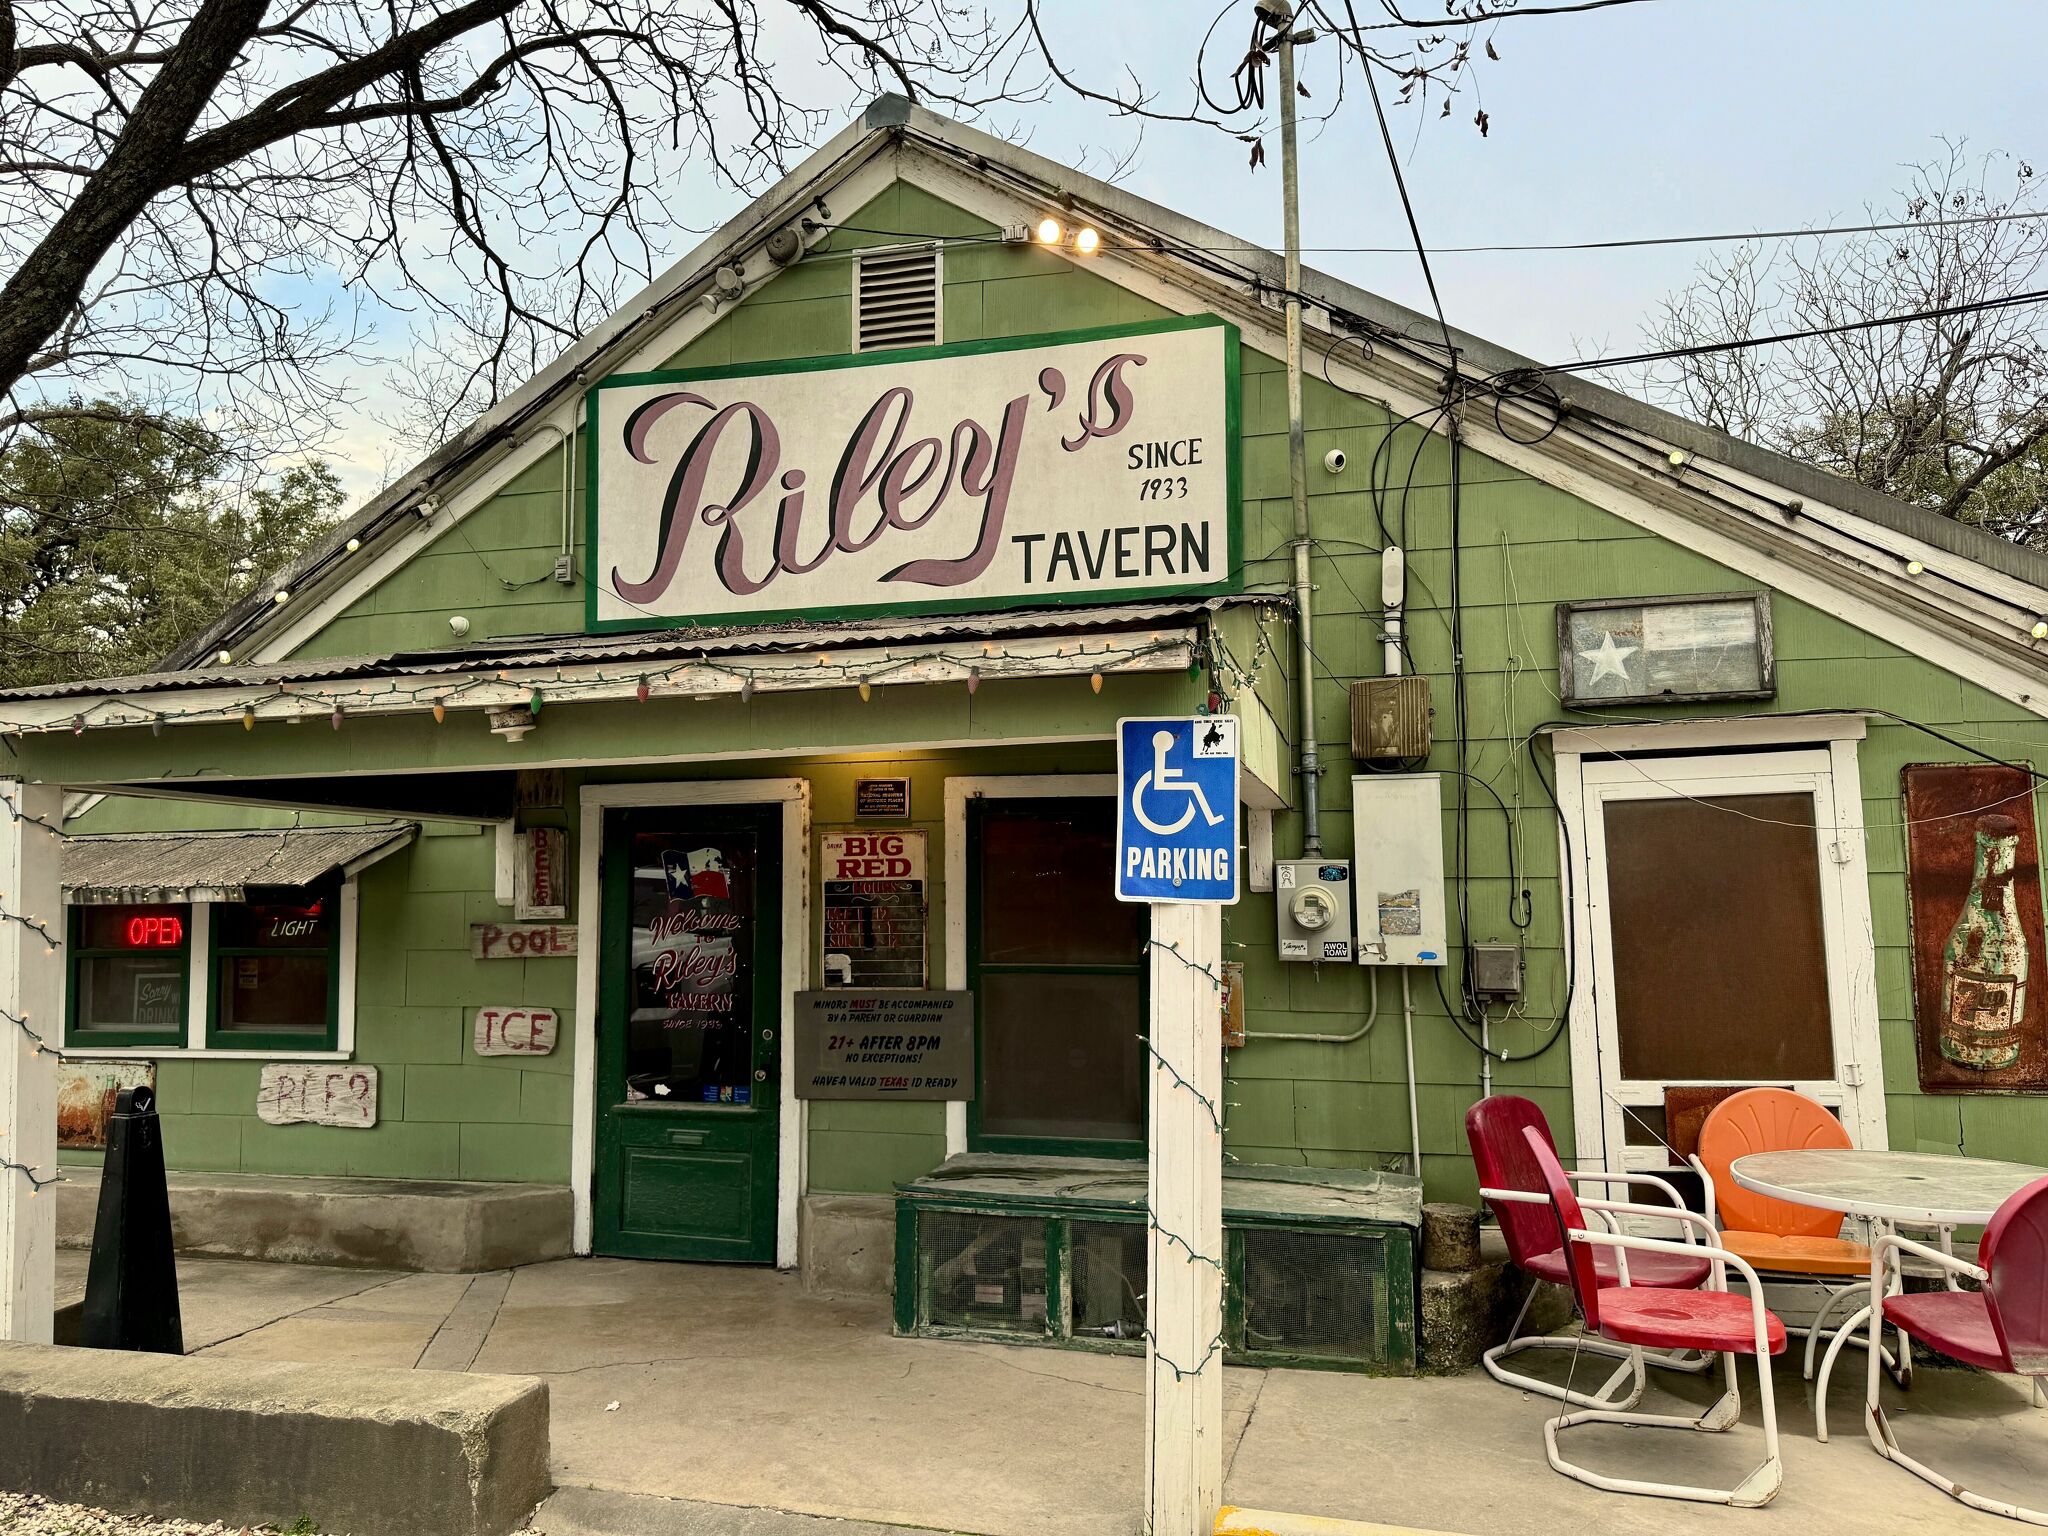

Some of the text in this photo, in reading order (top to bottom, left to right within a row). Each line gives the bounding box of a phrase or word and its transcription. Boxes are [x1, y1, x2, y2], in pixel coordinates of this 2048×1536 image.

[1127, 437, 1203, 471] SINCE
[611, 353, 1148, 604] Riley's
[1139, 476, 1189, 501] 1933
[1011, 520, 1210, 584] TAVERN
[843, 836, 904, 857] BIG
[836, 858, 912, 878] RED
[1126, 847, 1229, 881] PARKING
[852, 881, 897, 895] HOURS
[271, 919, 319, 937] LIGHT
[649, 909, 740, 947] Welcome
[482, 924, 568, 958] POOL
[1324, 942, 1347, 950] AWOL
[652, 945, 738, 993] Riley's
[140, 982, 172, 1002] Sorry
[665, 992, 733, 1013] TAVERN
[813, 999, 954, 1010] MINORS MUST BE ACCOMPANIED
[827, 1013, 943, 1023] BY A PARENT OR GUARDIAN
[828, 1035, 941, 1052] 21+ AFTER 8PM
[845, 1053, 923, 1064] NO EXCEPTIONS!
[812, 1076, 839, 1088] HAVE
[849, 1077, 877, 1087] VALID
[879, 1077, 909, 1088] TEXAS
[911, 1077, 923, 1088] ID
[925, 1077, 958, 1089] READY
